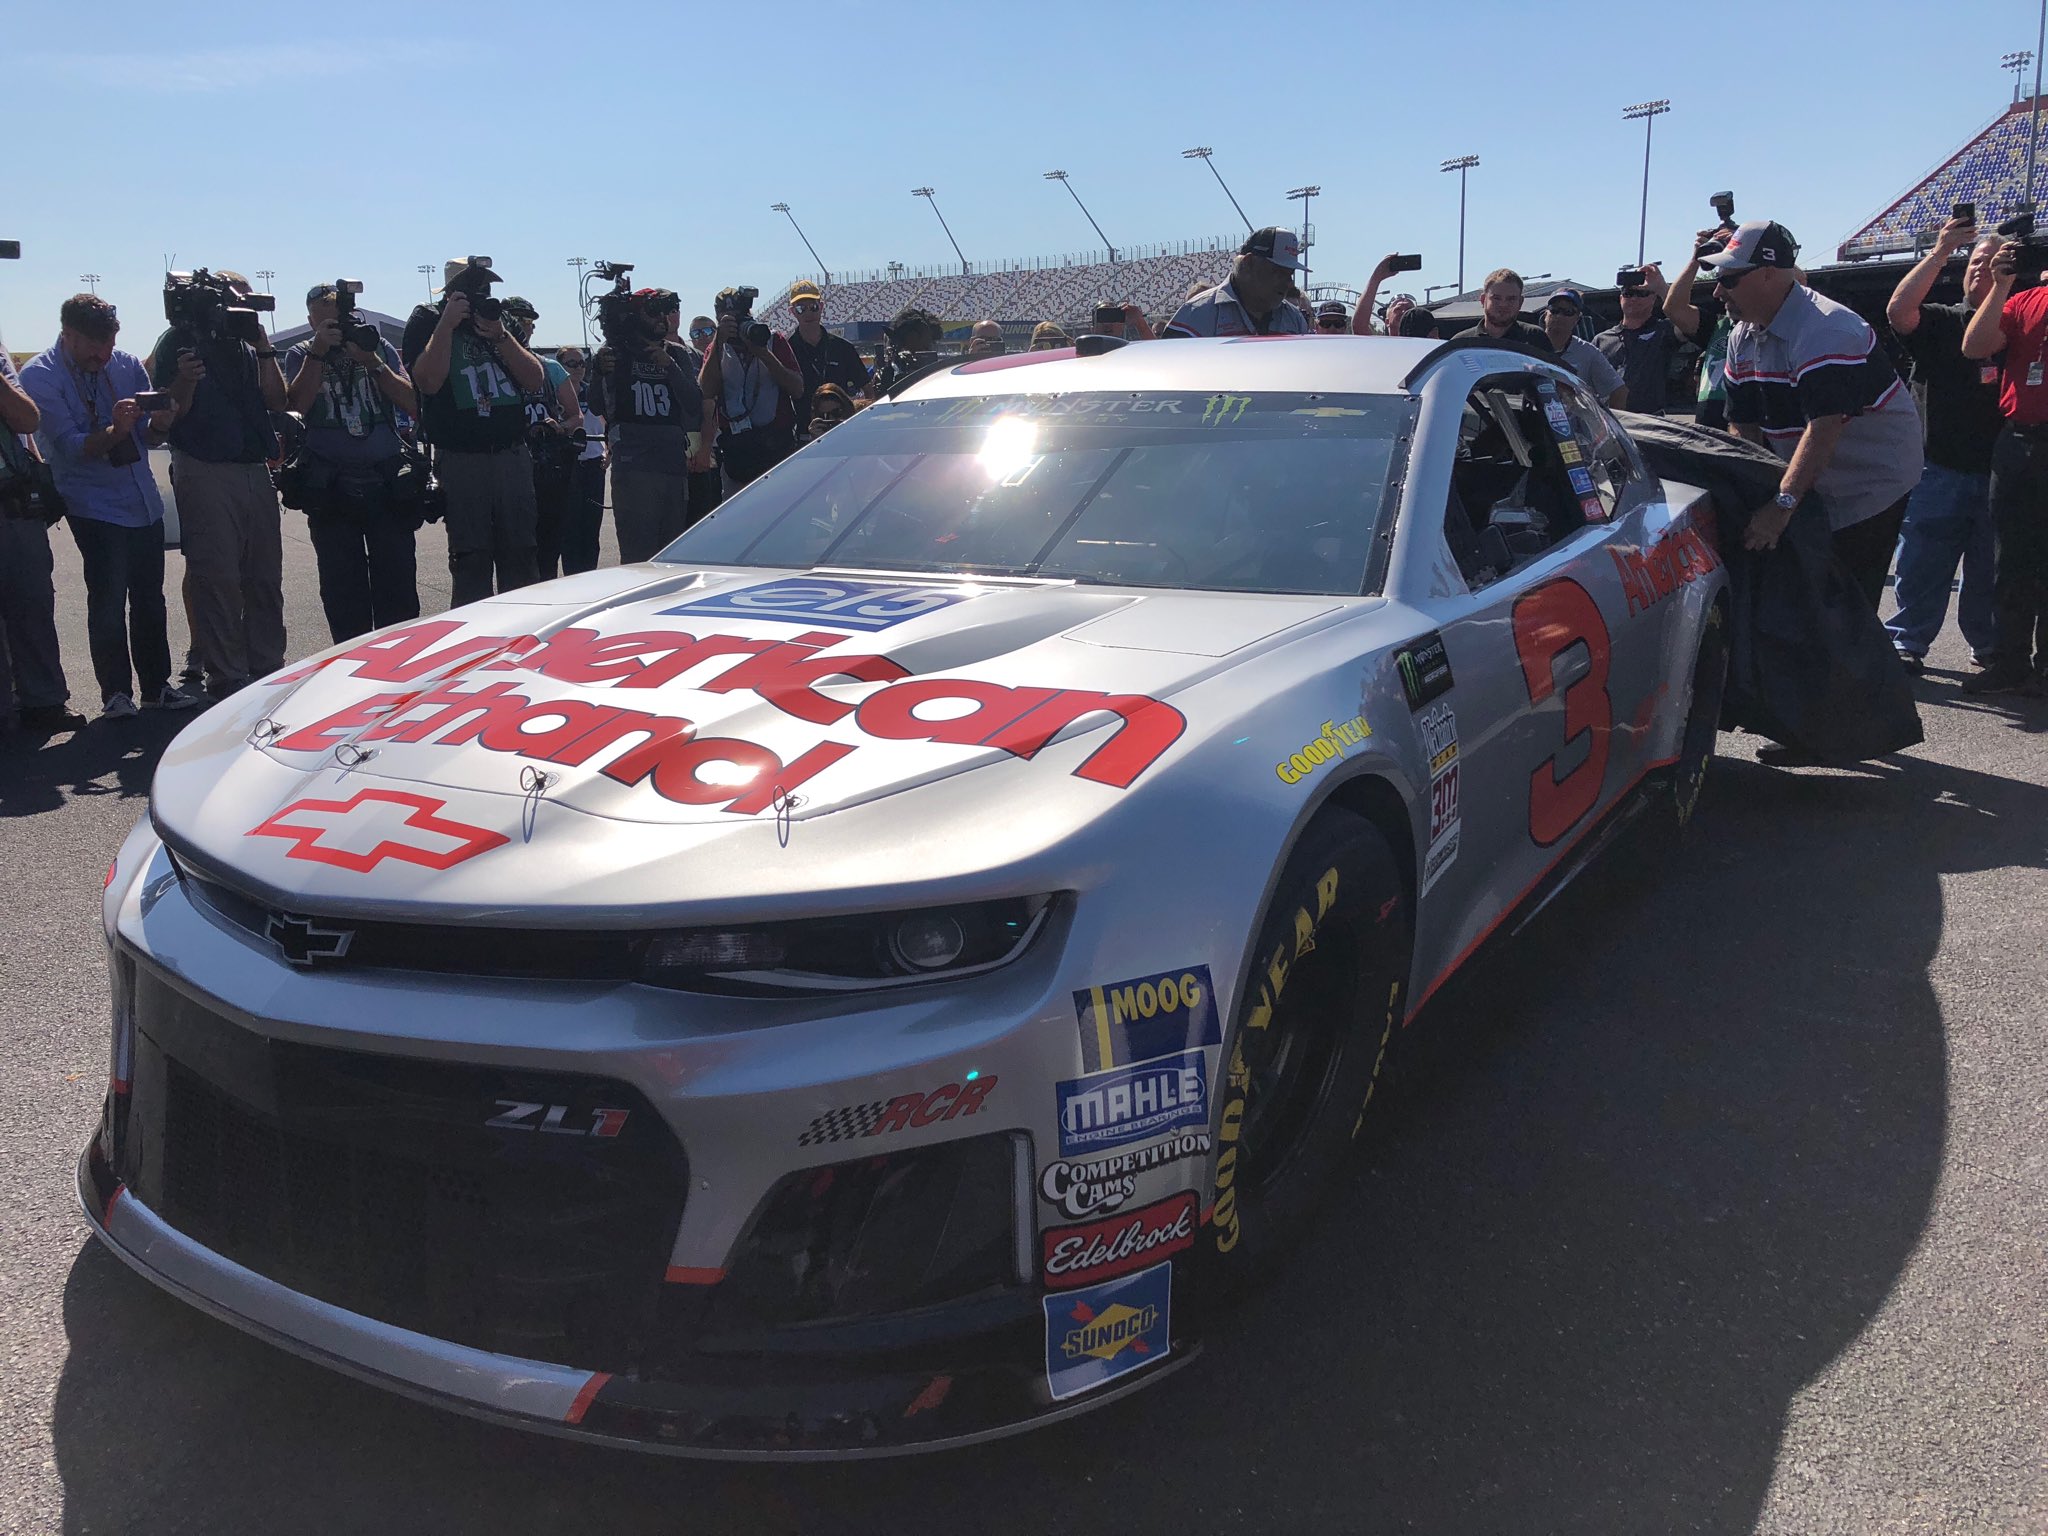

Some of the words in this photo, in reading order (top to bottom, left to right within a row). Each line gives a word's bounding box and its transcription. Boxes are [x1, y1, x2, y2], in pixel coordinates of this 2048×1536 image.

[1762, 247, 1777, 261] 3
[631, 380, 671, 417] 103
[262, 620, 1187, 789] American
[1511, 576, 1613, 848] 3
[268, 680, 859, 815] Ethanol
[1275, 714, 1373, 785] GOODYEAR
[1110, 972, 1201, 1025] MOOG
[485, 1100, 630, 1138] ZL1
[870, 1074, 998, 1136] RCR
[1065, 1123, 1126, 1145] ENGINE
[1130, 1104, 1202, 1131] BEARINGS
[1066, 1066, 1200, 1132] MAHLE
[1042, 1134, 1212, 1201] COMPETITION
[1064, 1174, 1136, 1216] CAMS
[1045, 1206, 1193, 1274] Edelbrock
[1067, 1305, 1155, 1356] SUNOCO
